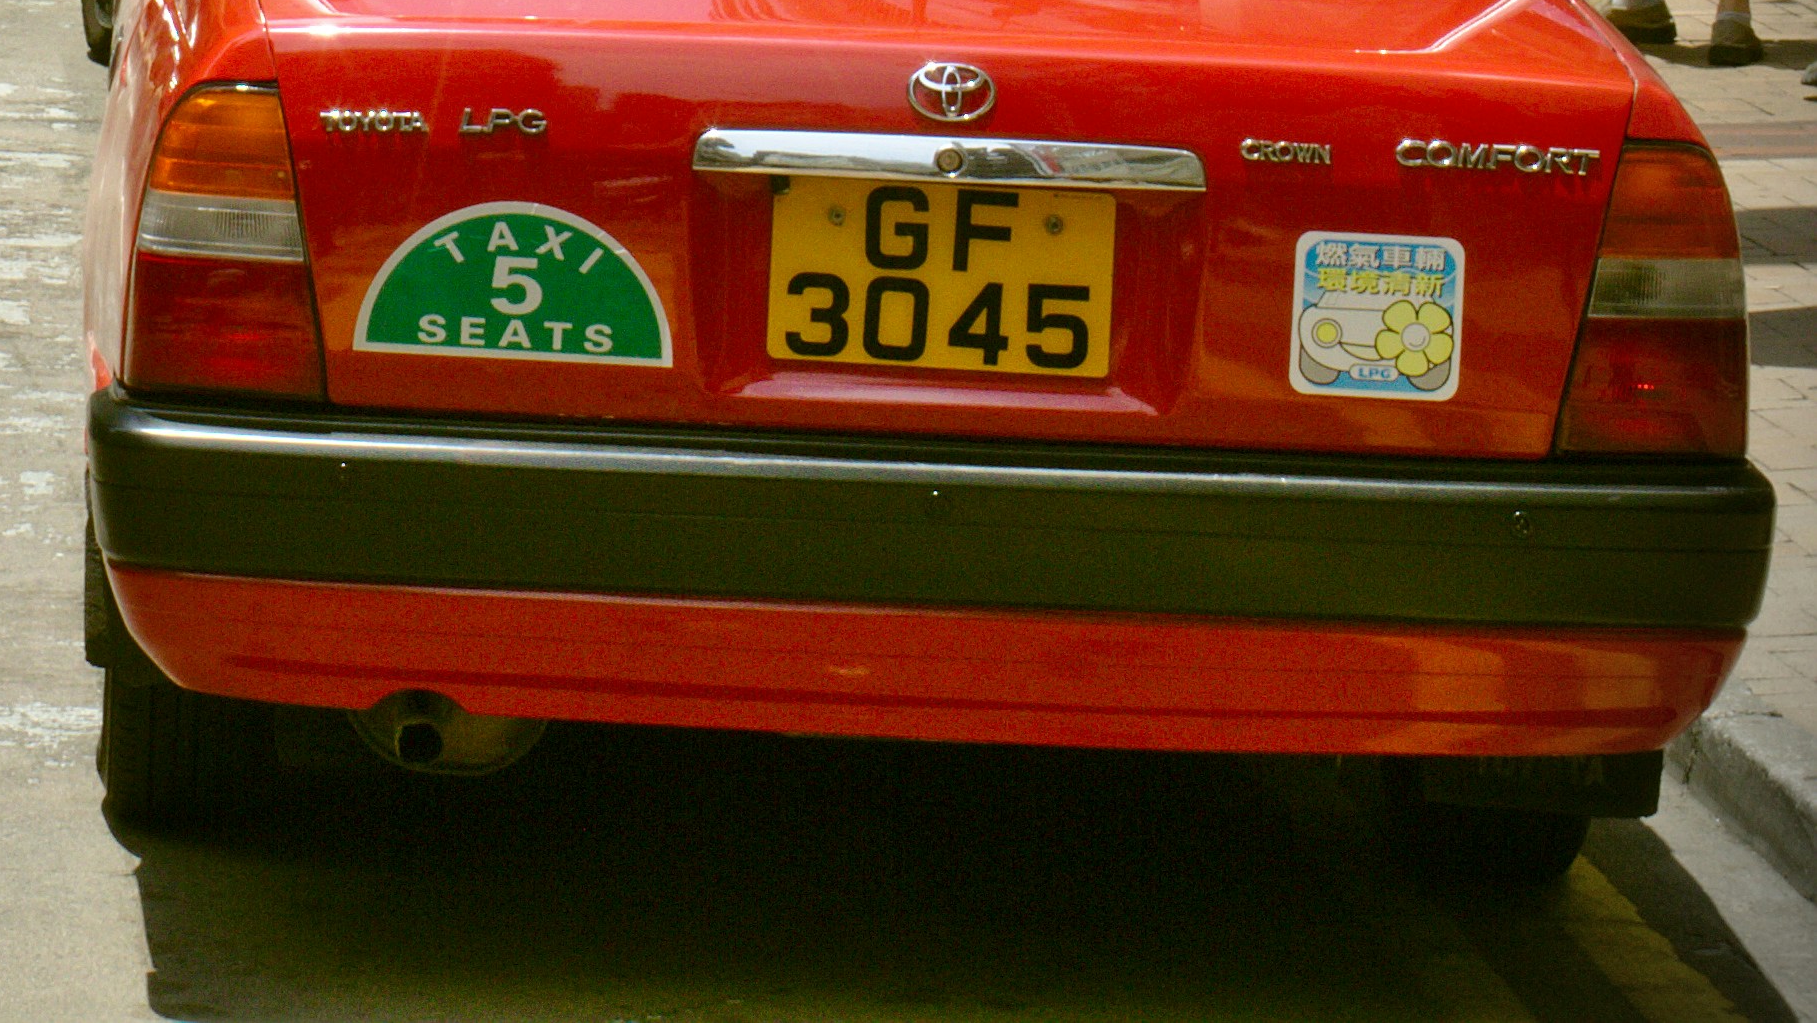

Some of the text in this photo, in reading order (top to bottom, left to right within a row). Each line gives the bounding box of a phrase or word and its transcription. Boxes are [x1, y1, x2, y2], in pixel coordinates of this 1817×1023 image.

[319, 107, 548, 134] TOYOTA LPG
[1239, 136, 1601, 176] CROWN COMFORT
[433, 220, 604, 275] TAXI
[864, 185, 1019, 272] GF
[1316, 241, 1447, 272] 燃氣車輛
[490, 255, 543, 316] 5
[417, 313, 614, 353] SEATS
[785, 271, 1091, 370] 3045
[1357, 365, 1393, 381] LPG
